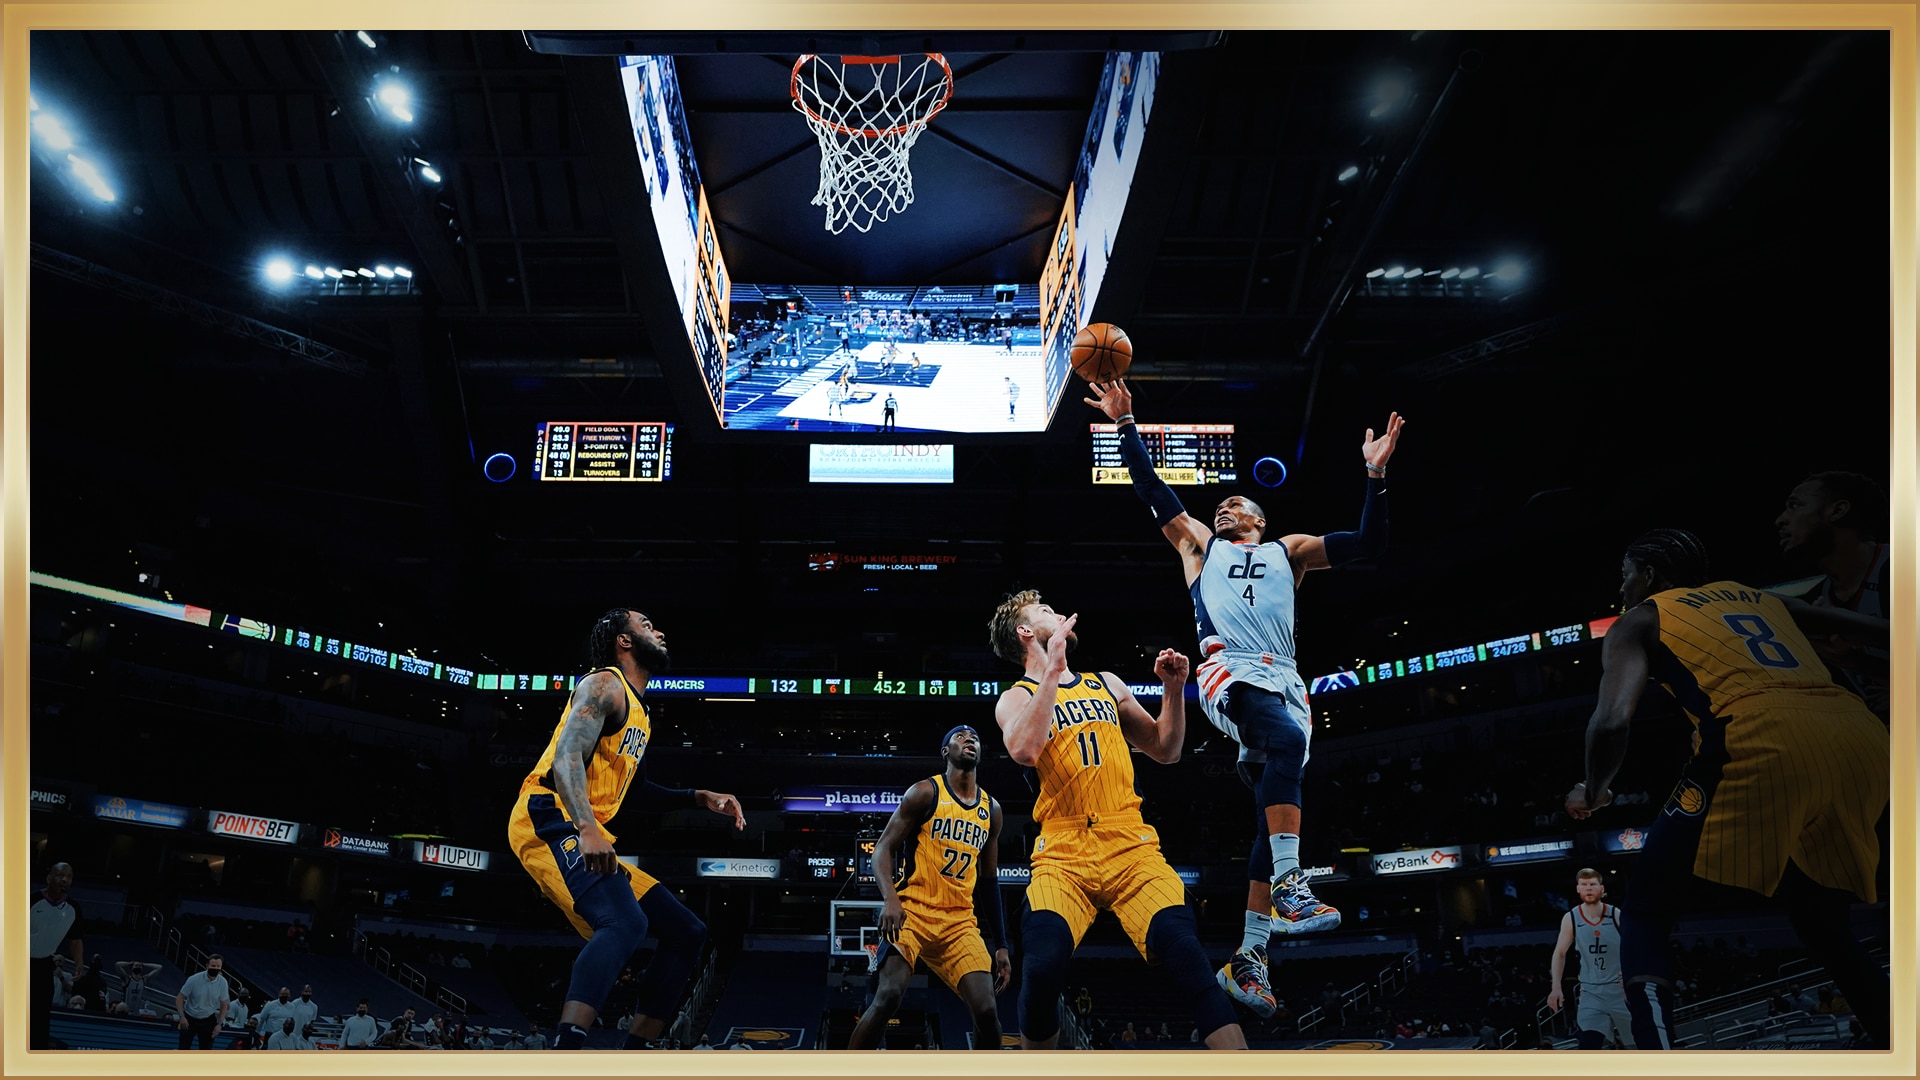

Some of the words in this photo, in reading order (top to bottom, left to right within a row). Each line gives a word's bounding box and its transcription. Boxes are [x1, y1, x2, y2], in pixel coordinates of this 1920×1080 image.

[534, 430, 544, 472] PACERS
[664, 427, 674, 477] WIZARDS
[843, 555, 867, 564] SUN
[870, 555, 898, 564] KING
[900, 555, 958, 564] BREWERY
[1228, 551, 1267, 579] dc
[1242, 584, 1256, 607] 4
[1676, 590, 1762, 609] HOLIDAY
[296, 638, 310, 648] 48
[1550, 631, 1580, 646] 9/32
[1722, 614, 1800, 669] 8
[325, 645, 339, 655] 33
[1492, 642, 1527, 658] 24/28
[352, 650, 388, 666] 50/102
[1436, 653, 1476, 668] 49/108
[402, 662, 429, 676] 25/30
[1378, 669, 1392, 680] 59
[1408, 663, 1422, 674] 26
[449, 672, 470, 685] 7/28
[520, 681, 527, 690] 2
[554, 681, 562, 690] 0
[663, 680, 705, 690] PACERS
[771, 680, 798, 693] 132
[829, 685, 837, 693] 6
[873, 681, 906, 694] 45.2
[929, 685, 944, 695] OT
[972, 681, 998, 695] 131
[1049, 698, 1118, 740] ACERS
[1077, 731, 1101, 767] 11
[30, 790, 67, 805] PHICS
[825, 791, 877, 807] planet
[213, 813, 295, 840] POINTSBET
[931, 818, 989, 850] PACERS
[342, 836, 389, 850] DATABANK
[442, 847, 481, 868] IUPUI
[808, 858, 835, 866] PACERS
[940, 848, 972, 880] 22
[730, 863, 777, 873] Kinetico
[1374, 856, 1429, 874] KeyBank
[814, 868, 829, 877] 132
